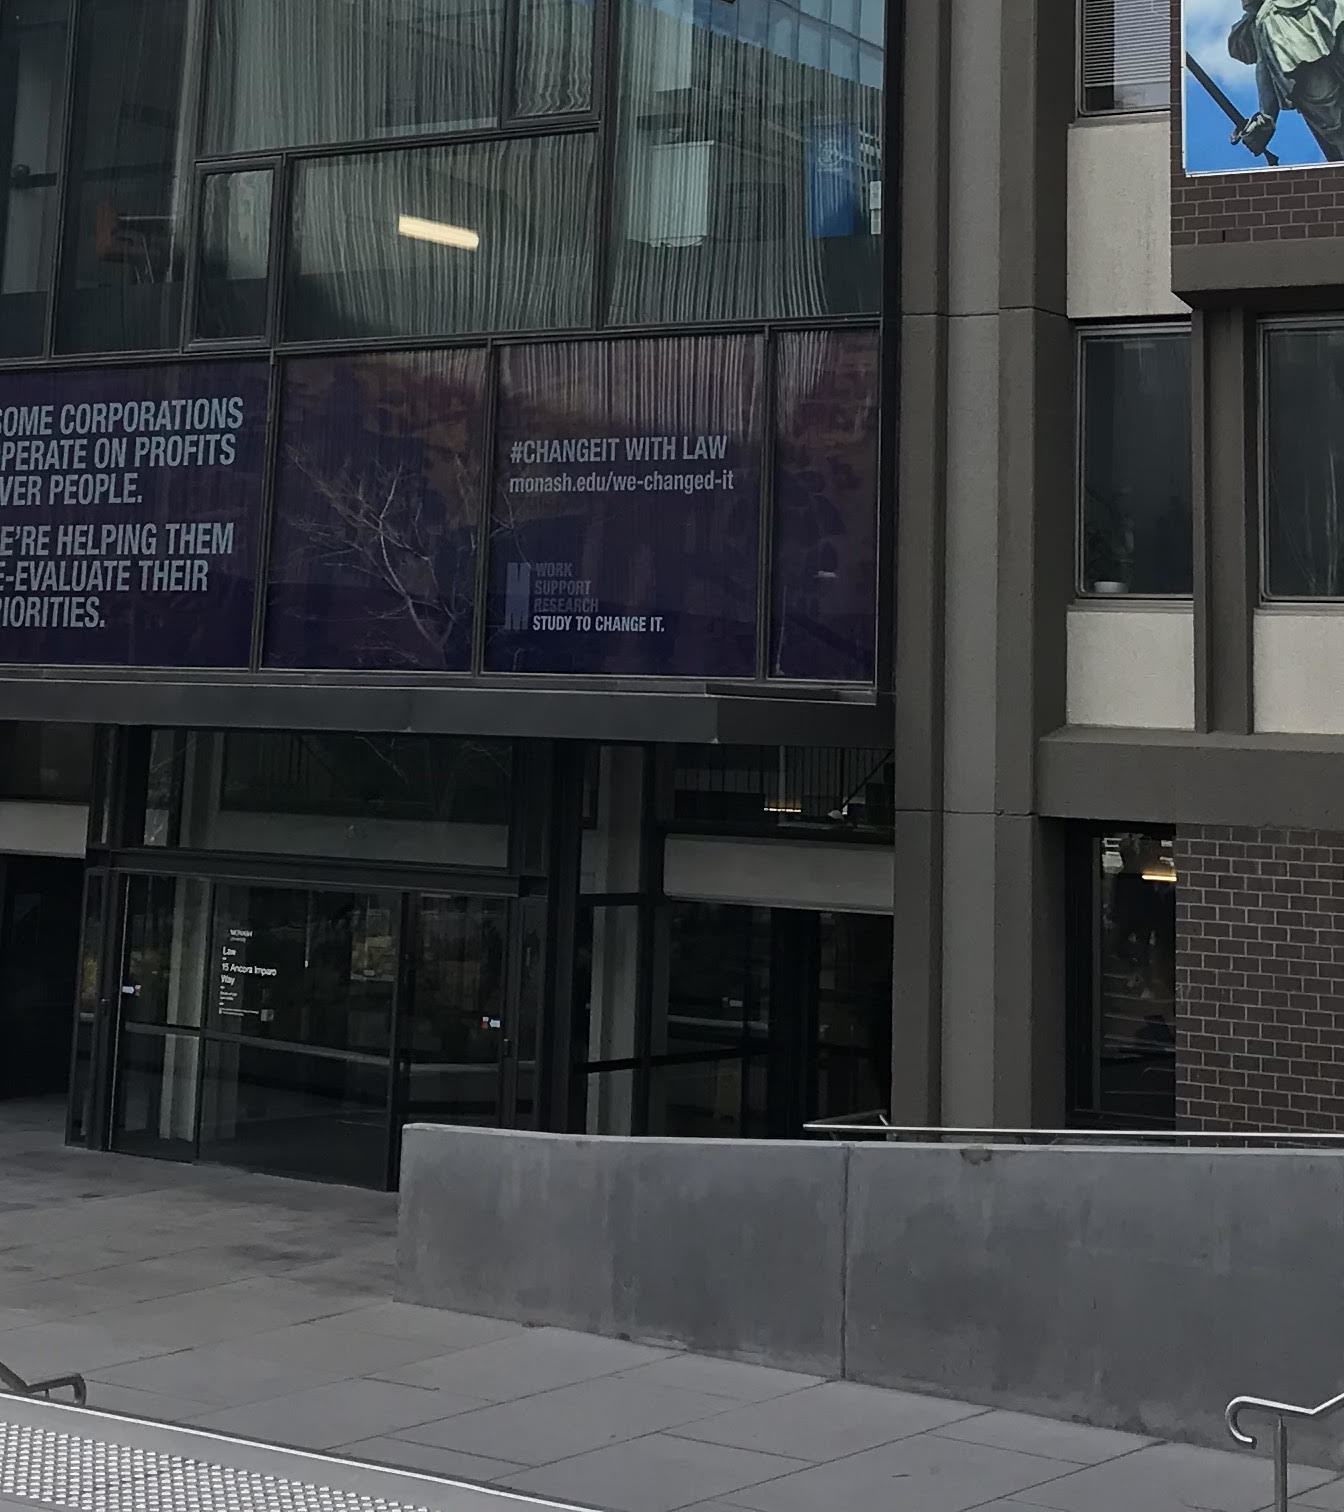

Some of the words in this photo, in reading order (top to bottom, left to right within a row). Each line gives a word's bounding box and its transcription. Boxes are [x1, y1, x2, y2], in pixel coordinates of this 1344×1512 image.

[60, 397, 243, 435] CORPORATIONS
[94, 437, 126, 469] ON
[134, 434, 236, 467] PROFITS
[510, 438, 620, 464] #CHANGEIT
[625, 436, 676, 461] WITH
[682, 435, 727, 460] LAW
[49, 473, 143, 505] PEOPLE.
[509, 469, 734, 494] monash.edu/we-changed-it
[56, 523, 156, 556] HELPING
[165, 522, 234, 555] THEM
[139, 560, 209, 592] THEIR
[535, 562, 573, 577] WORK
[534, 580, 592, 595] SUPPORT
[533, 598, 599, 613] RESEARCH
[532, 615, 573, 631] STUDY
[575, 615, 591, 631] TO
[595, 616, 646, 632] CHANGE
[650, 616, 665, 632] IT.
